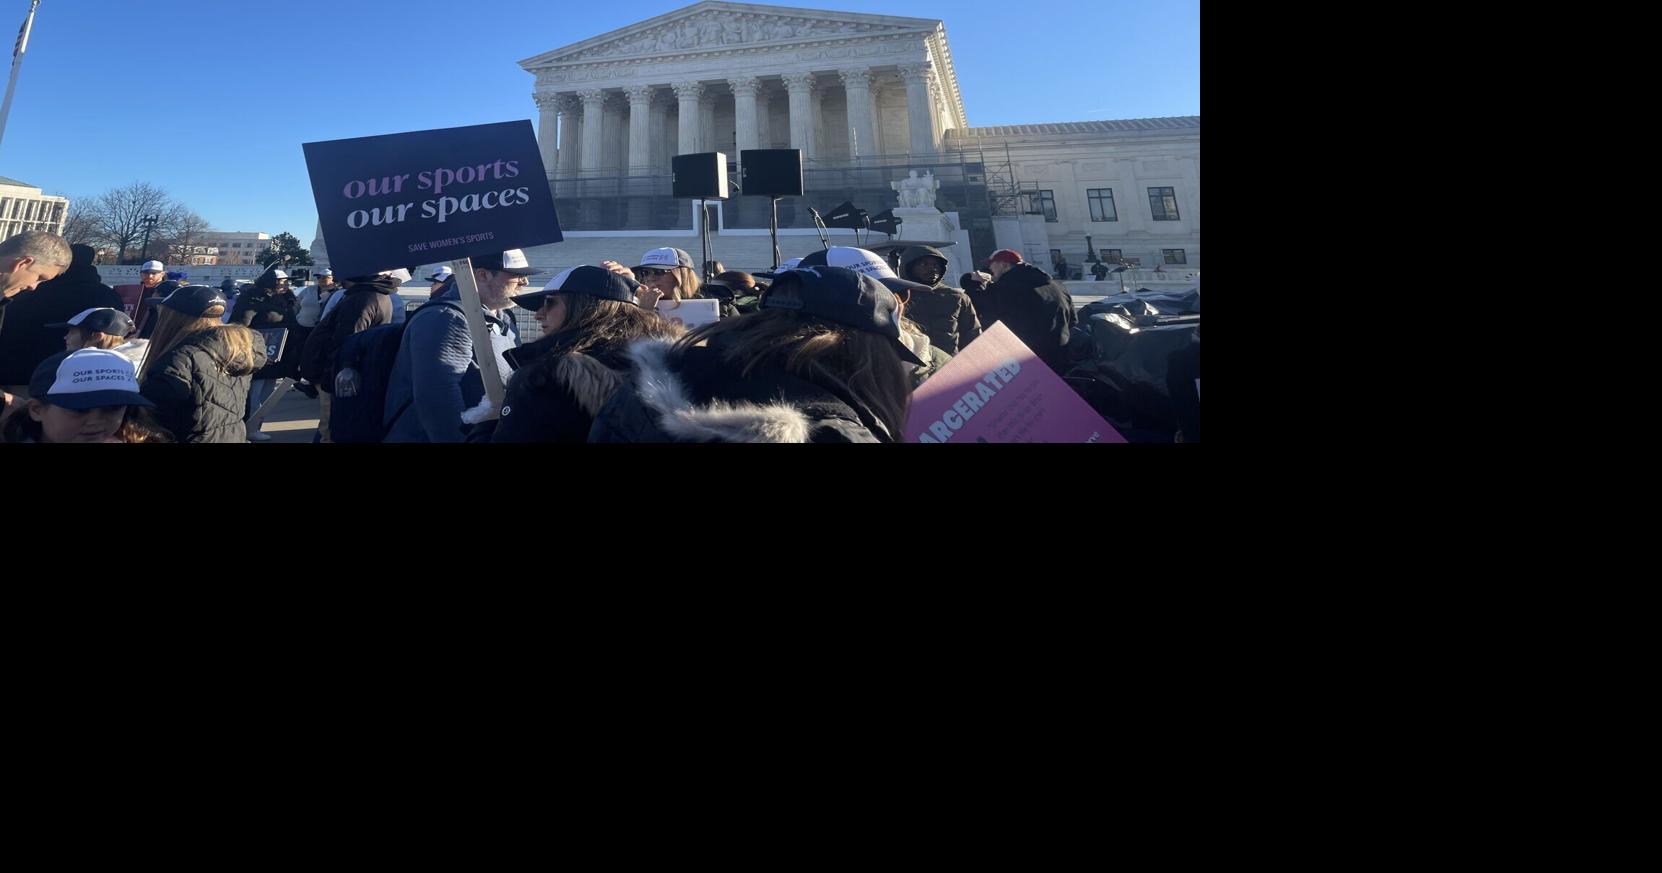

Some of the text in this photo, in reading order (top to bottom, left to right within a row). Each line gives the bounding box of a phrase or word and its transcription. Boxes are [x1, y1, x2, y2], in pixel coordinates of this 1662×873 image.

[343, 157, 520, 199] our sports
[347, 186, 530, 229] our spaces
[407, 231, 495, 253] SAVE WOMEN'S SPORTS
[72, 375, 93, 384] OUR
[73, 369, 93, 377] OUR
